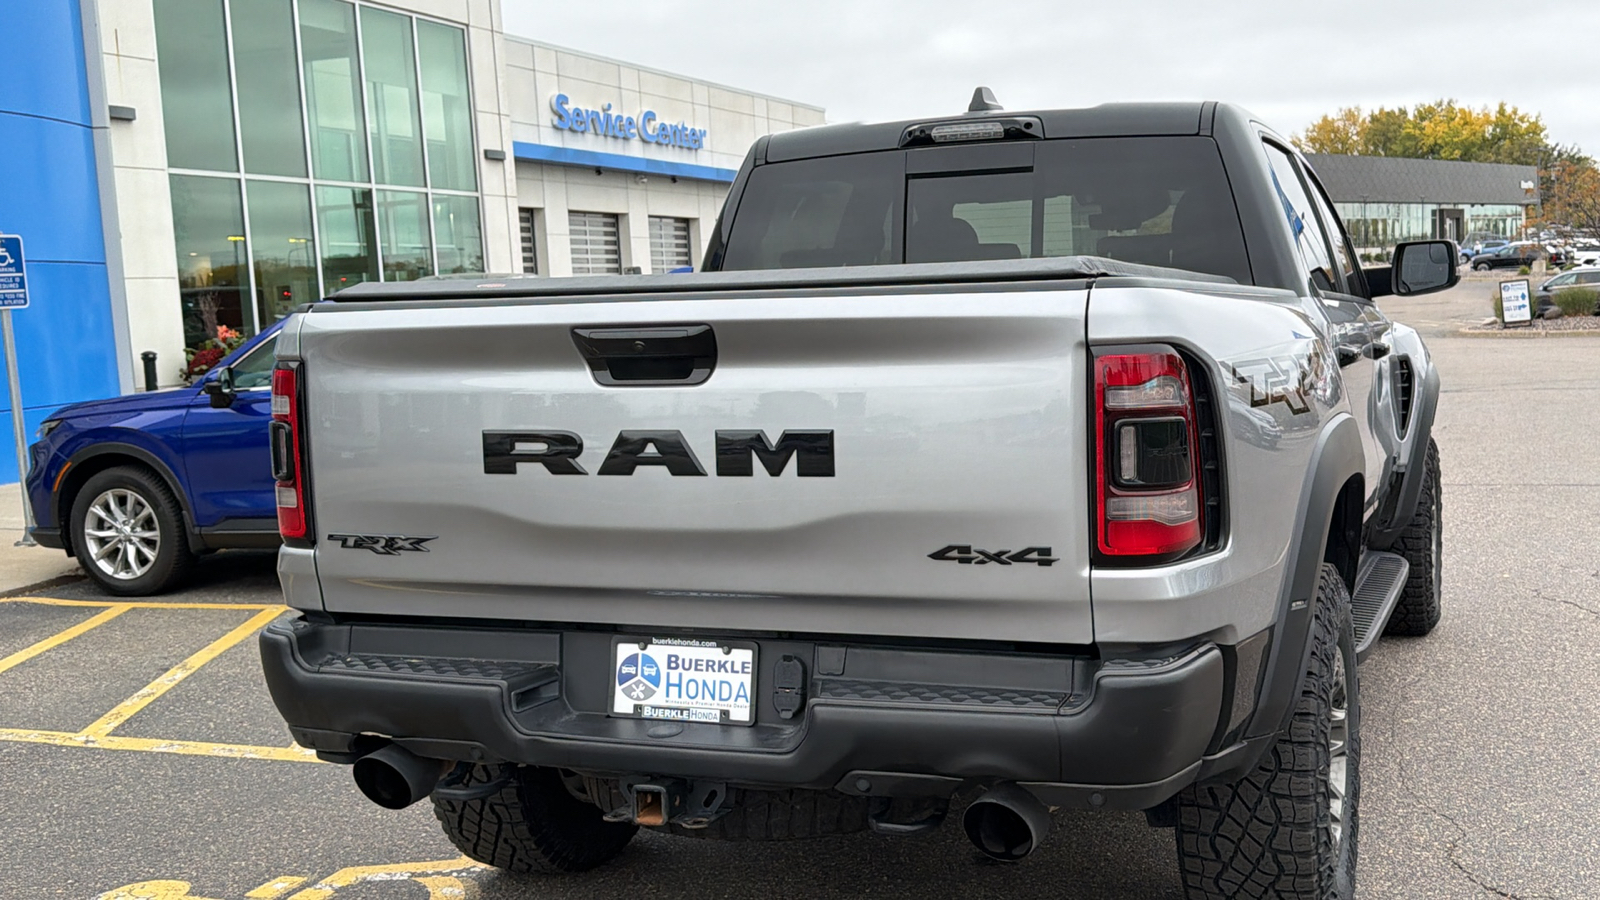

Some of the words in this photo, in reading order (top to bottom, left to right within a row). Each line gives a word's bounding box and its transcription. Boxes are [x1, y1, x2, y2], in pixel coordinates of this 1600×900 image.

[550, 93, 637, 139] Service
[637, 110, 706, 149] Center
[482, 429, 835, 477] RAM
[327, 533, 439, 556] TRX
[927, 544, 1060, 567] 4x4
[653, 637, 717, 647] buerklehonda.com
[666, 653, 751, 674] BUERKLE
[665, 671, 749, 703] HONDA
